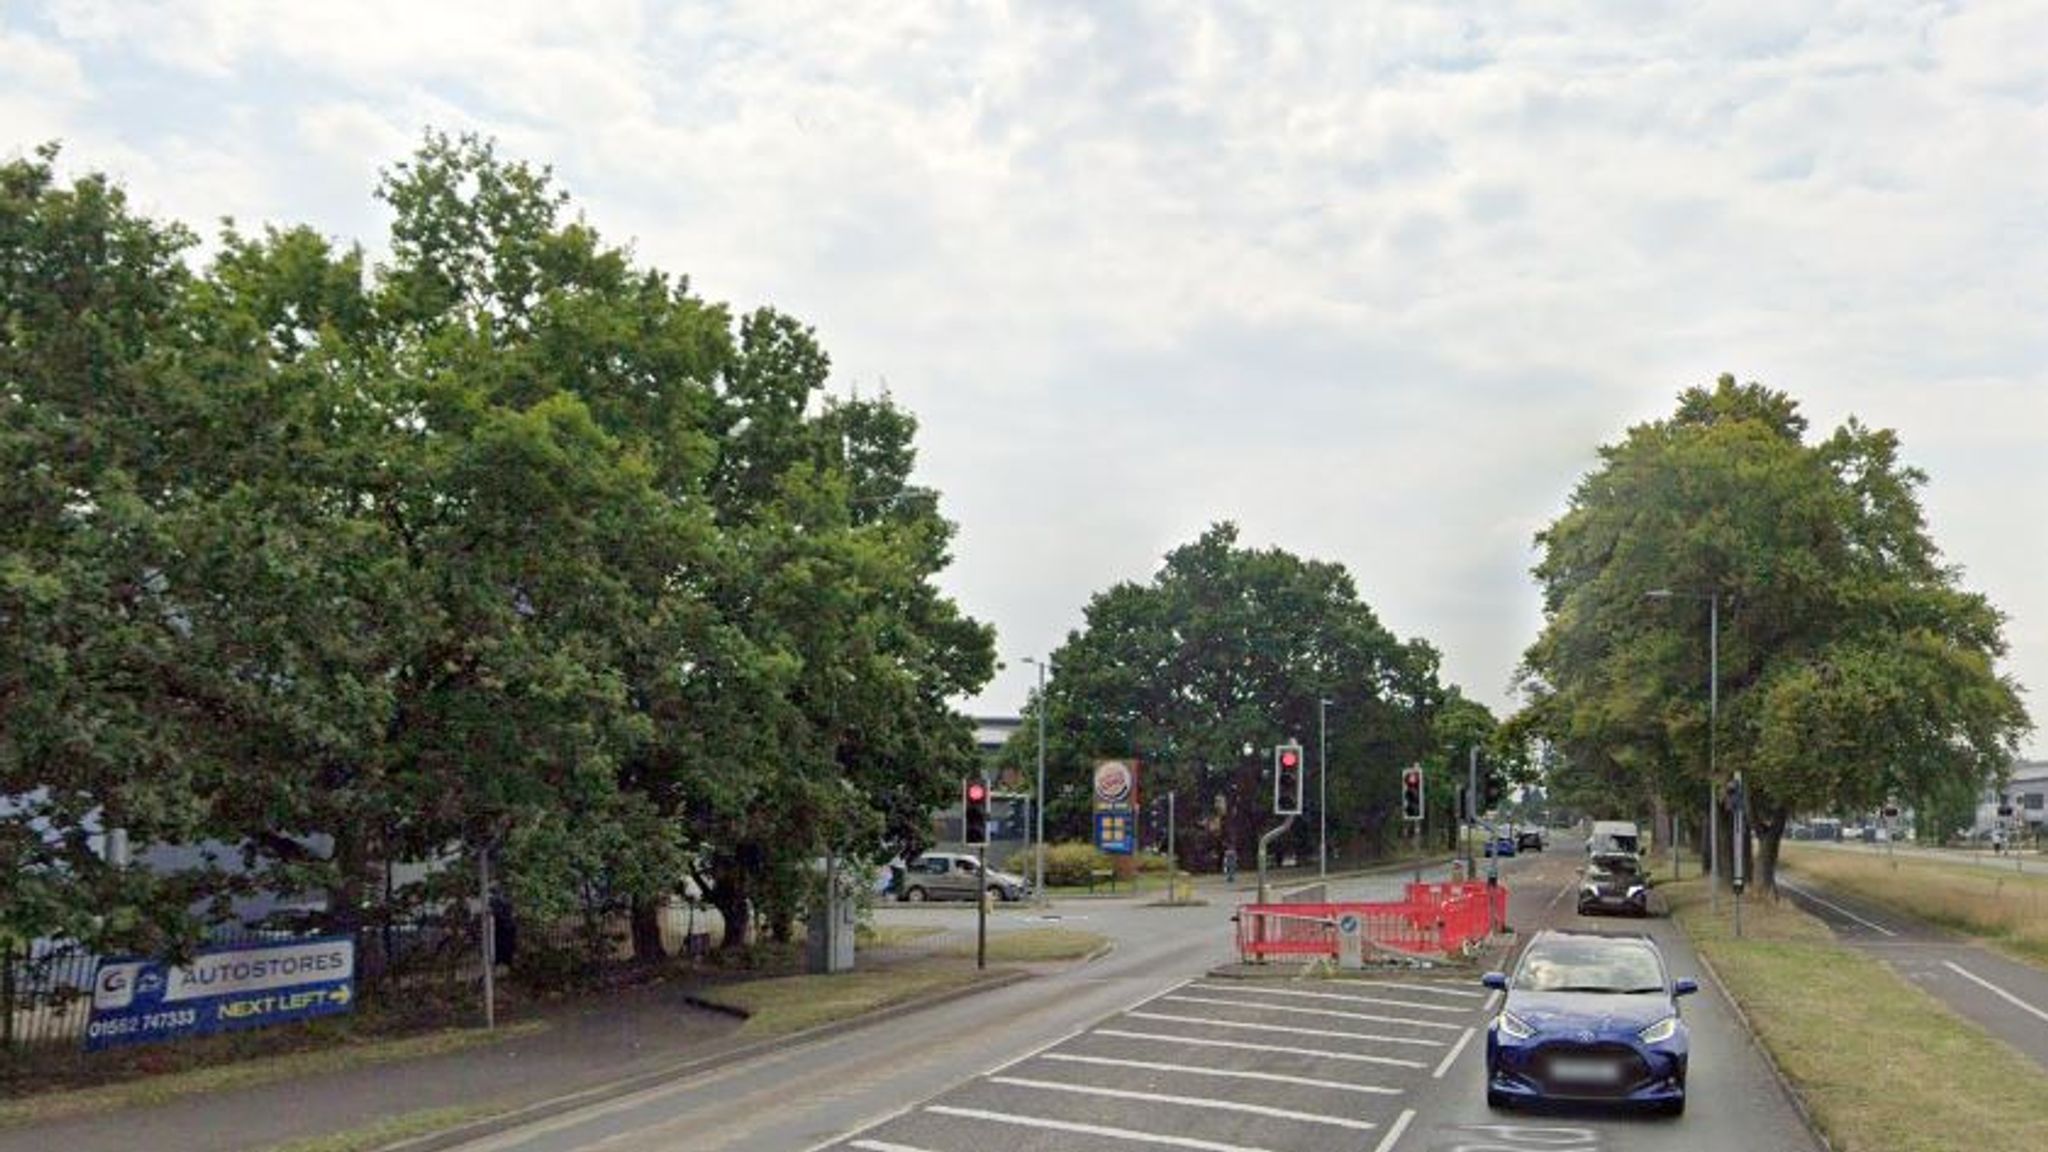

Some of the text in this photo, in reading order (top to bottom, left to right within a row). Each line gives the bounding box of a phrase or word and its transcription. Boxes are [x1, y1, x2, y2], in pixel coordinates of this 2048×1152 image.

[181, 951, 343, 985] AUTOSTORES
[218, 991, 327, 1018] NEXT LEFT
